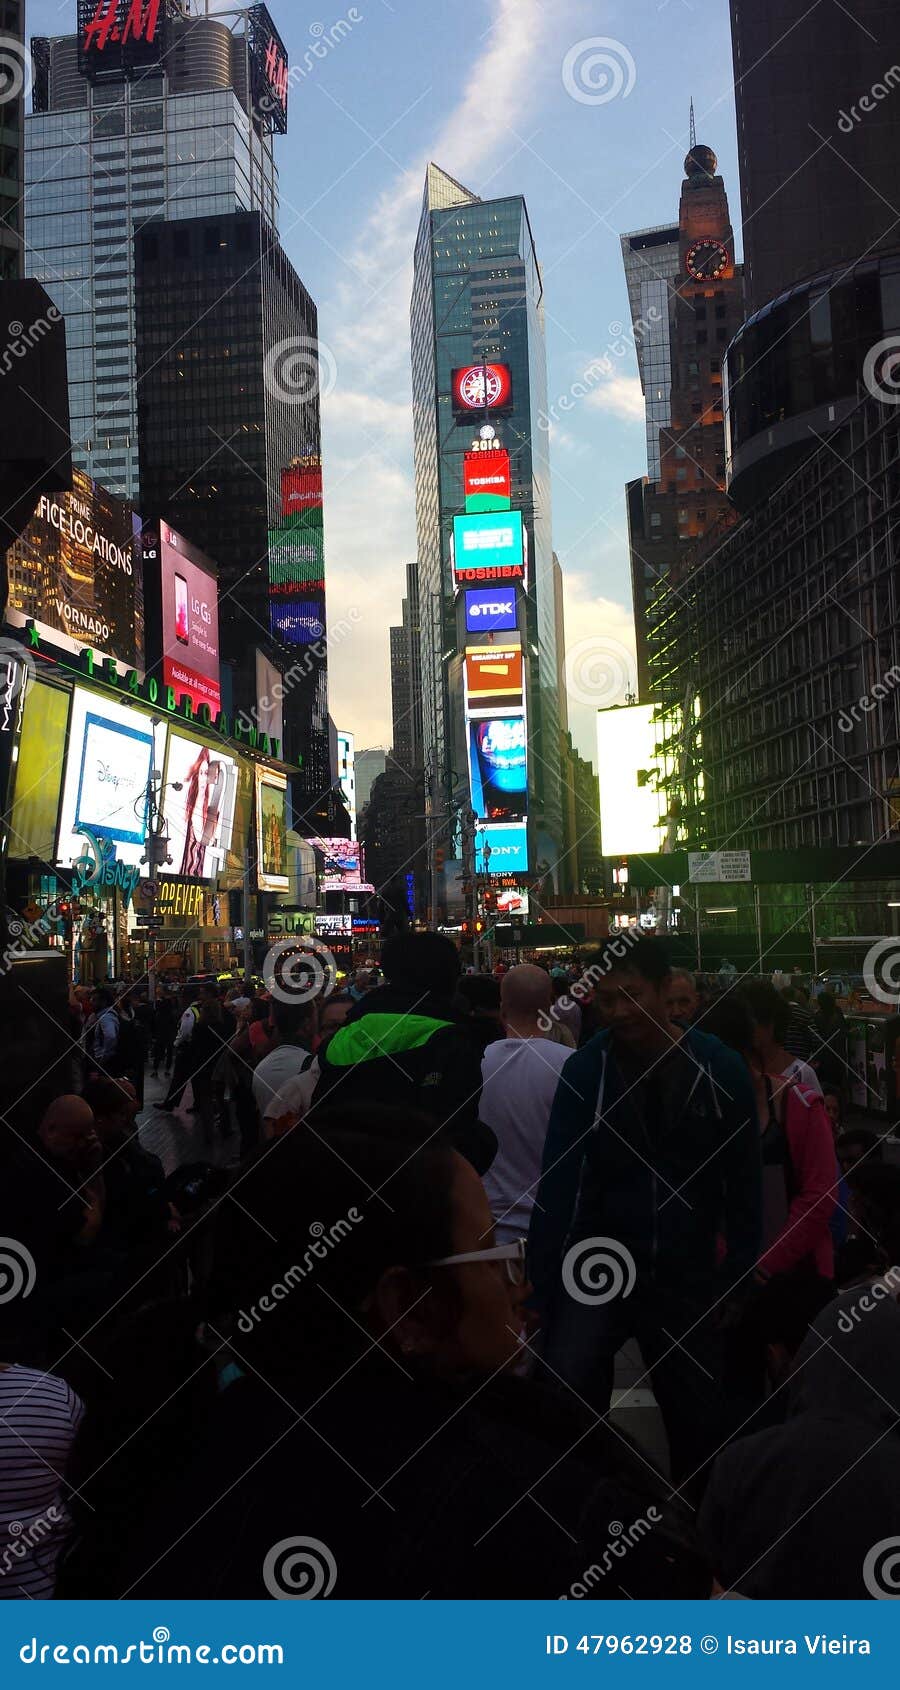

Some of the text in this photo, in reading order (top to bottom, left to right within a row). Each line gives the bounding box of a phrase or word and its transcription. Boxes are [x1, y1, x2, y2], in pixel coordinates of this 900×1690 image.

[83, 0, 158, 51] H&M
[472, 439, 500, 451] 2014
[465, 449, 508, 460] TOSHIBA
[468, 476, 506, 486] TOSHIBA
[69, 494, 92, 523] PRIME
[39, 495, 133, 576] FICE LOCATIONS
[143, 550, 156, 559] LG
[456, 564, 523, 581] TOSHIBA
[191, 596, 200, 615] LG
[479, 602, 513, 615] TDK
[55, 598, 109, 640] VORNADO
[83, 648, 281, 758] 1540 BROADWAY
[480, 846, 522, 856] ONY
